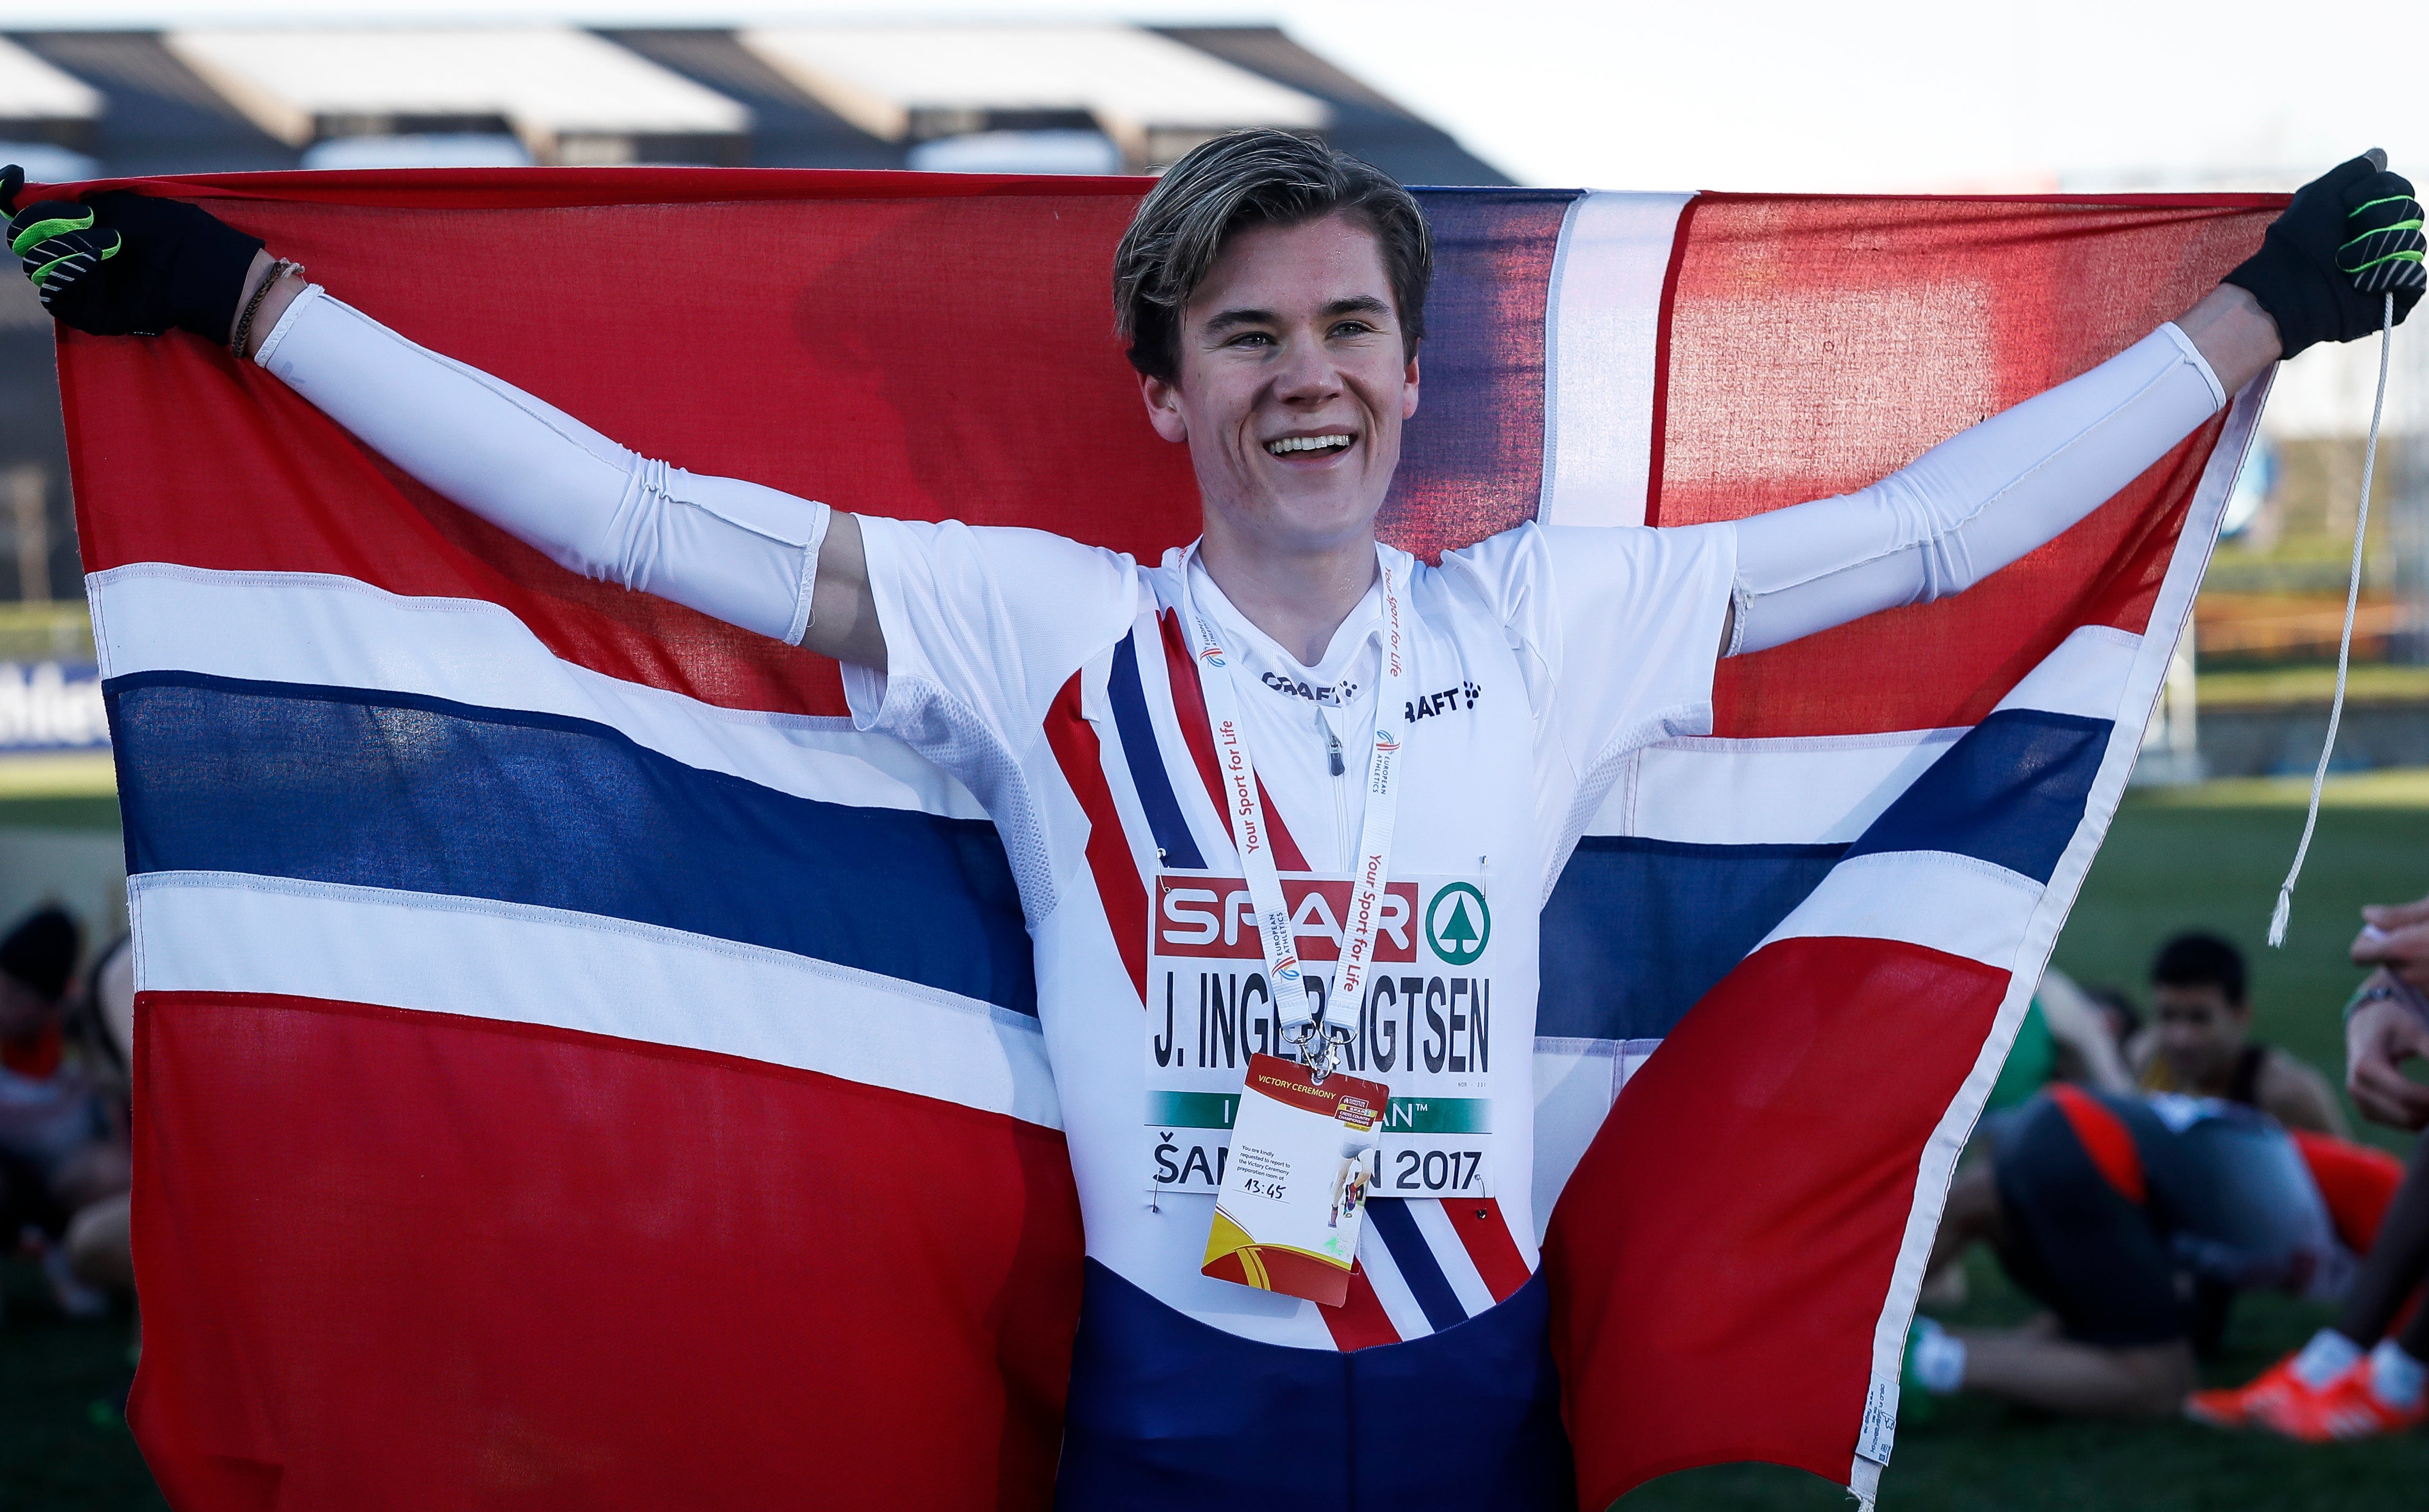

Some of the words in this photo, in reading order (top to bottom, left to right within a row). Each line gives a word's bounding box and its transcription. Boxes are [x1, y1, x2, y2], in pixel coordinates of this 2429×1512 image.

[1386, 594, 1399, 629] Sport
[1390, 629, 1401, 651] for
[1390, 652, 1402, 677] Life
[1405, 687, 1459, 723] RAFT
[1220, 720, 1237, 745] Life
[1229, 749, 1243, 771] for
[1373, 754, 1382, 793] ATHLETICS
[1381, 756, 1390, 795] EUROPEAN
[1233, 775, 1254, 816] Sport
[1245, 820, 1259, 854] Your
[1366, 855, 1382, 888] Your
[1162, 888, 1410, 950] SPAR
[1356, 891, 1376, 935] Sport
[1269, 914, 1283, 955] EUROPEAN
[1277, 912, 1290, 953] ATHLETICS
[1351, 938, 1368, 961] for
[1344, 965, 1361, 992] Life
[1154, 971, 1184, 1068] J.
[1259, 1075, 1292, 1089] VICTORY
[1292, 1083, 1337, 1100] CEREMONY
[1240, 1153, 1263, 1162] requested
[1248, 1161, 1264, 1170] Victory
[1265, 1165, 1290, 1176] Ceremony
[1260, 1149, 1274, 1158] kindly
[1396, 1150, 1482, 1190] 2017
[1237, 1166, 1264, 1177] preparation
[1244, 1178, 1286, 1199] 13:45
